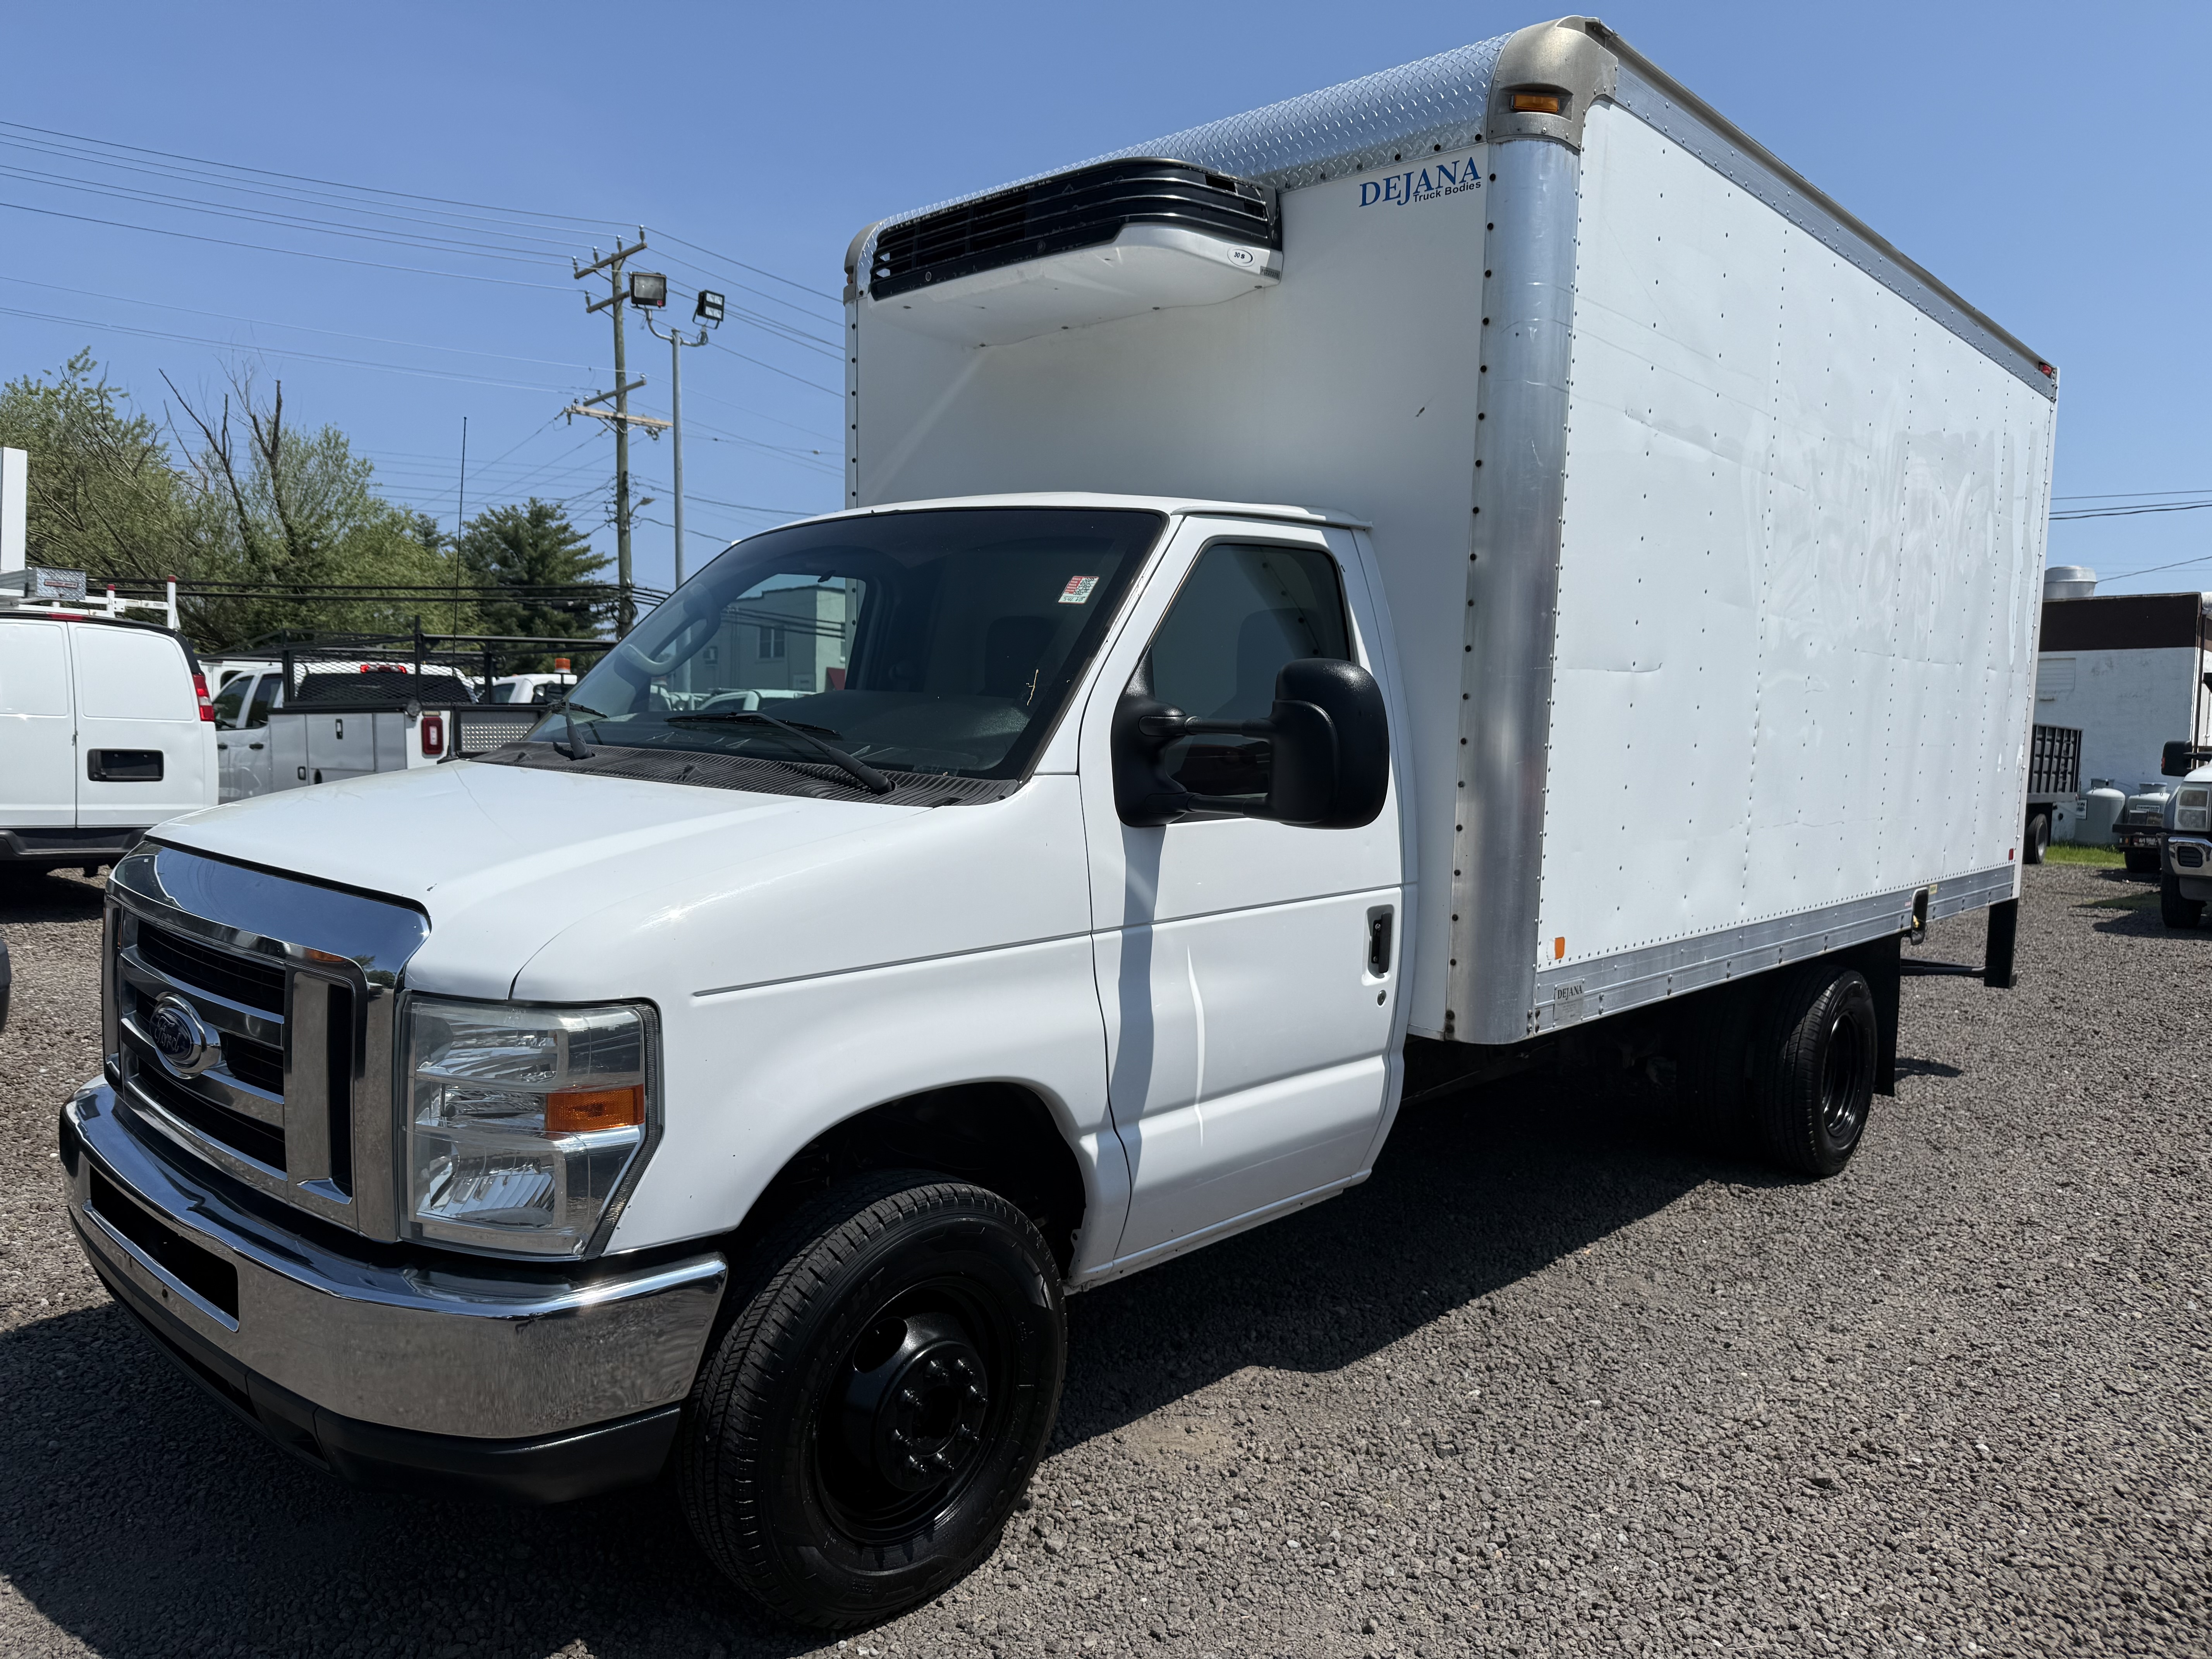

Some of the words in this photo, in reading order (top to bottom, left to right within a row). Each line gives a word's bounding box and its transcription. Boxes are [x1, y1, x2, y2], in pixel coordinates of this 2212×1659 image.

[1358, 156, 1482, 207] DEJANA
[1413, 190, 1441, 203] Truck
[1445, 181, 1481, 196] Bodies
[1558, 985, 1582, 1000] DEJANA
[155, 1015, 179, 1052] Ford
